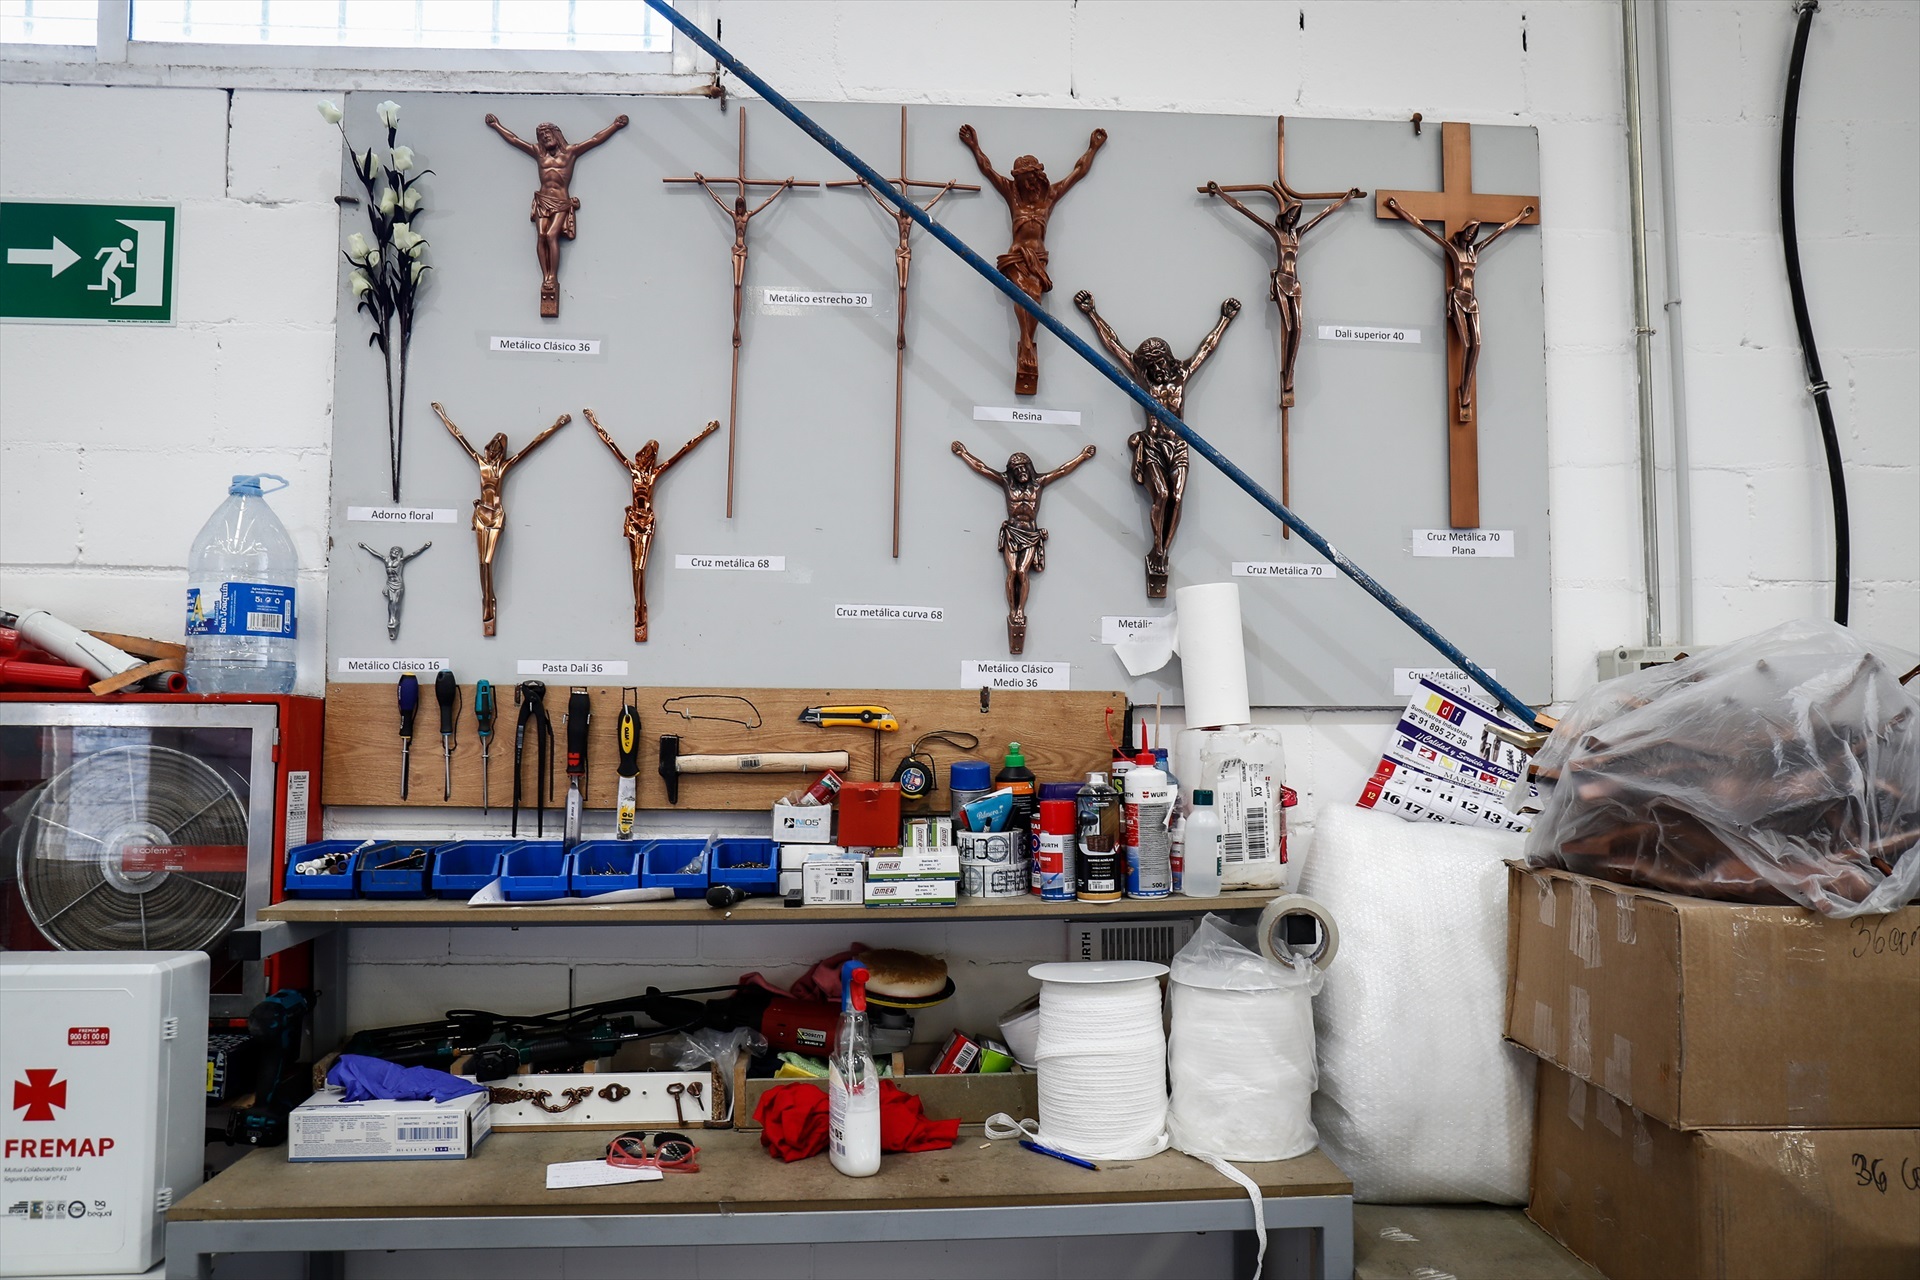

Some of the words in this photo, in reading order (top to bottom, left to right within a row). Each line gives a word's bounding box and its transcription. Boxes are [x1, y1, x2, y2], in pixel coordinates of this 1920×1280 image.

[769, 293, 811, 304] Metálico
[812, 295, 853, 305] estrecho
[855, 295, 868, 305] 30
[1354, 331, 1391, 343] superior
[1392, 331, 1405, 341] 40
[500, 339, 542, 350] Metálico
[543, 341, 576, 352] Clásico
[578, 342, 591, 352] 36
[1012, 410, 1042, 421] Resina
[371, 510, 407, 520] Adorno
[409, 510, 434, 521] floral
[1426, 532, 1447, 542] Cruz
[1449, 531, 1487, 542] Metálica
[1488, 532, 1500, 542] 70
[1452, 545, 1476, 555] Plana
[691, 557, 712, 567] Cruz
[714, 558, 755, 568] metálica
[757, 559, 770, 569] 68
[1246, 565, 1267, 575] Cruz
[1269, 566, 1308, 576] Metálica
[1310, 566, 1323, 576] 70
[219, 584, 230, 617] Joaquín
[836, 607, 858, 617] Cruz
[860, 607, 900, 618] metálica
[902, 610, 928, 619] curva
[930, 610, 943, 620] 68
[219, 618, 227, 634] San
[1118, 619, 1153, 629] Metáli
[348, 660, 390, 670] Metálico
[392, 660, 426, 671] Clásico
[428, 661, 440, 670] 16
[542, 663, 568, 673] Pasta
[591, 663, 603, 673] 36
[977, 663, 1019, 674] Metálico
[1021, 664, 1054, 674] Clásico
[1408, 670, 1424, 680] Cru
[993, 678, 1024, 688] Medio
[1026, 678, 1038, 688] 36
[1410, 704, 1442, 723] Suministros
[1442, 720, 1473, 740] Industriales
[1418, 716, 1428, 727] 91
[1429, 722, 1445, 735] 895
[1444, 731, 1456, 741] 27
[1456, 736, 1468, 747] 38
[1444, 772, 1482, 788] MARZO
[1482, 786, 1505, 796] 2020
[1366, 791, 1376, 800] 12
[1382, 791, 1402, 805] 16
[1404, 802, 1424, 814] 17
[1426, 812, 1446, 822] 18
[1460, 800, 1480, 814] 12
[1482, 810, 1502, 824] 13
[1505, 820, 1524, 833] 14
[878, 862, 899, 870] OMER
[1082, 931, 1091, 960] RTH
[4, 1137, 115, 1158] FREMAP
[4, 1176, 33, 1184] Seguridad
[1852, 1153, 1887, 1195] 36
[87, 1210, 112, 1218] bequal
